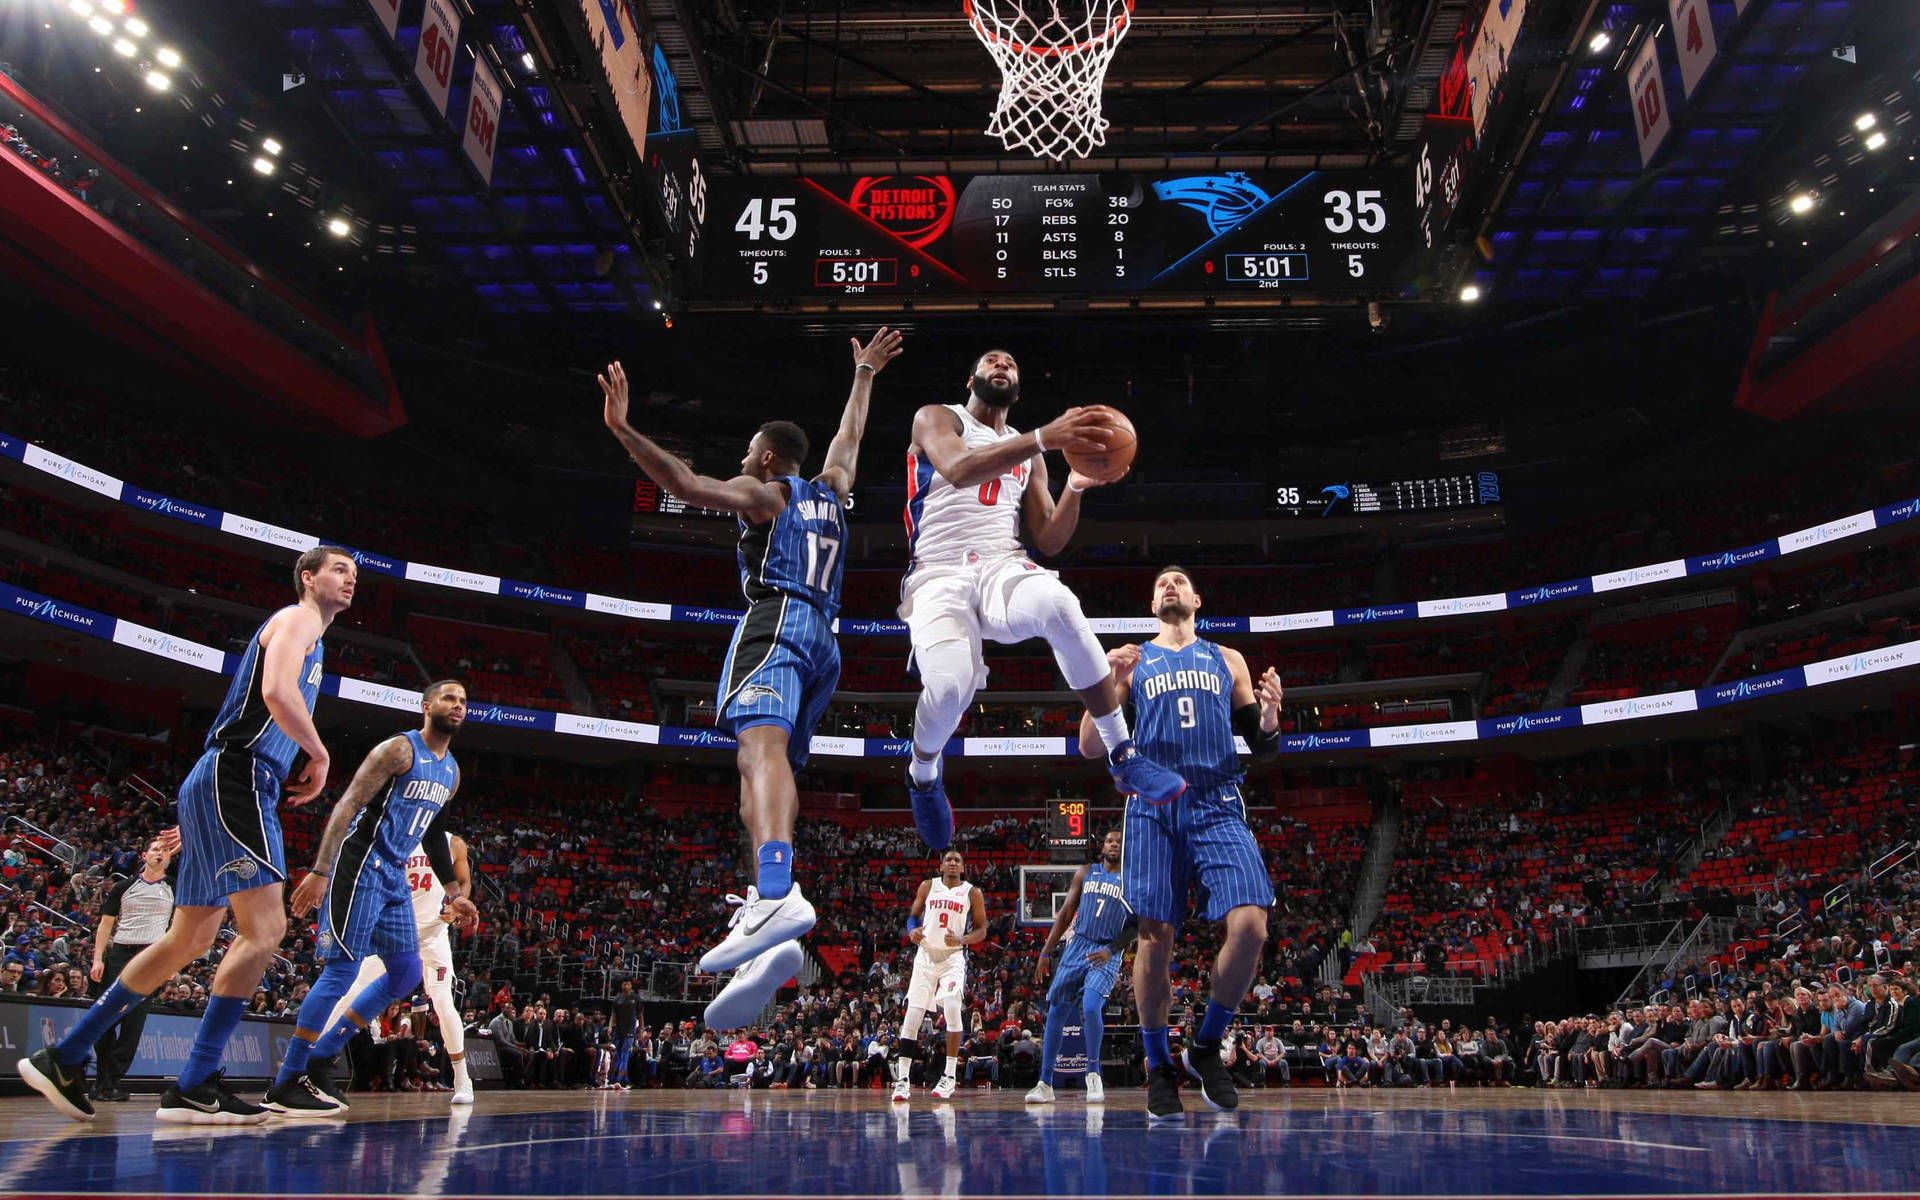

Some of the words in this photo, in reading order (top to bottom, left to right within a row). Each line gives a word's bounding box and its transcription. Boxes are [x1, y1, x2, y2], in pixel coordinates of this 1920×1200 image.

[422, 22, 451, 89] 40
[1638, 77, 1661, 139] 10
[1416, 142, 1432, 208] 45
[690, 158, 706, 225] 35
[871, 189, 936, 203] DETROIT
[991, 198, 1012, 209] 50
[1045, 199, 1074, 208] FG%
[1108, 197, 1128, 208] 38
[869, 204, 936, 220] PISTONS
[1324, 190, 1386, 233] 35
[735, 198, 797, 240] 45
[994, 215, 1010, 226] 17
[1042, 216, 1077, 225] REBS
[1108, 214, 1129, 225] 20
[996, 233, 1008, 243] 11
[1042, 233, 1077, 242] ASTS
[1114, 231, 1124, 242] 8
[1425, 222, 1432, 249] 5
[689, 231, 695, 258] 5
[1043, 250, 1077, 260] BLKS
[1116, 248, 1123, 260] 1
[832, 262, 879, 282] 5:01
[911, 265, 919, 277] 9
[997, 267, 1007, 278] 5
[1044, 267, 1077, 277] STLS
[1116, 266, 1125, 277] 3
[1244, 257, 1291, 277] 5:01
[1349, 255, 1364, 278] 5
[753, 262, 768, 284] 5
[845, 285, 865, 293] 2nd
[1259, 280, 1279, 288] 2nd
[42, 457, 62, 470] PURE
[978, 478, 1001, 506] 0
[1277, 487, 1300, 504] 35
[137, 495, 157, 506] PURE
[1891, 505, 1911, 516] PURE
[240, 524, 258, 534] PURE
[1795, 534, 1814, 544] PURE
[805, 530, 840, 592] 17
[1702, 558, 1721, 567] PURE
[423, 570, 441, 580] PURE
[1608, 576, 1626, 584] PURE
[514, 586, 531, 594] PURE
[1520, 592, 1537, 600] PURE
[601, 601, 618, 609] PURE
[16, 597, 39, 610] PURE
[30, 600, 94, 626] MICHIGAN
[137, 634, 158, 646] PURE
[1828, 664, 1850, 675] PURE
[1144, 670, 1220, 699] ORLANDO
[1716, 689, 1737, 699] PURE
[1731, 678, 1784, 701] MICHIGAN
[361, 689, 380, 698] PURE
[379, 688, 422, 707] MICHIGA
[467, 708, 488, 718] PURE
[481, 707, 535, 723] MICHIGAN
[1177, 696, 1196, 729] 9
[1604, 707, 1623, 716] PURE
[577, 722, 595, 730] PURE
[1497, 721, 1515, 730] PURE
[1511, 715, 1562, 733] MICHIGAN
[679, 733, 697, 741] PURE
[1391, 731, 1410, 739] PURE
[810, 741, 845, 750] ICHIGAN
[883, 743, 901, 751] PURE
[1301, 734, 1351, 750] MICHIGAN
[403, 780, 450, 808] ORLAND
[1059, 803, 1084, 815] 5:00
[408, 807, 434, 838] 14
[1068, 815, 1083, 837] 9
[408, 872, 432, 891] 34
[1083, 881, 1122, 900] ORLAND
[930, 899, 964, 914] PISTONS
[1095, 898, 1105, 917] 7
[939, 913, 949, 928] 9
